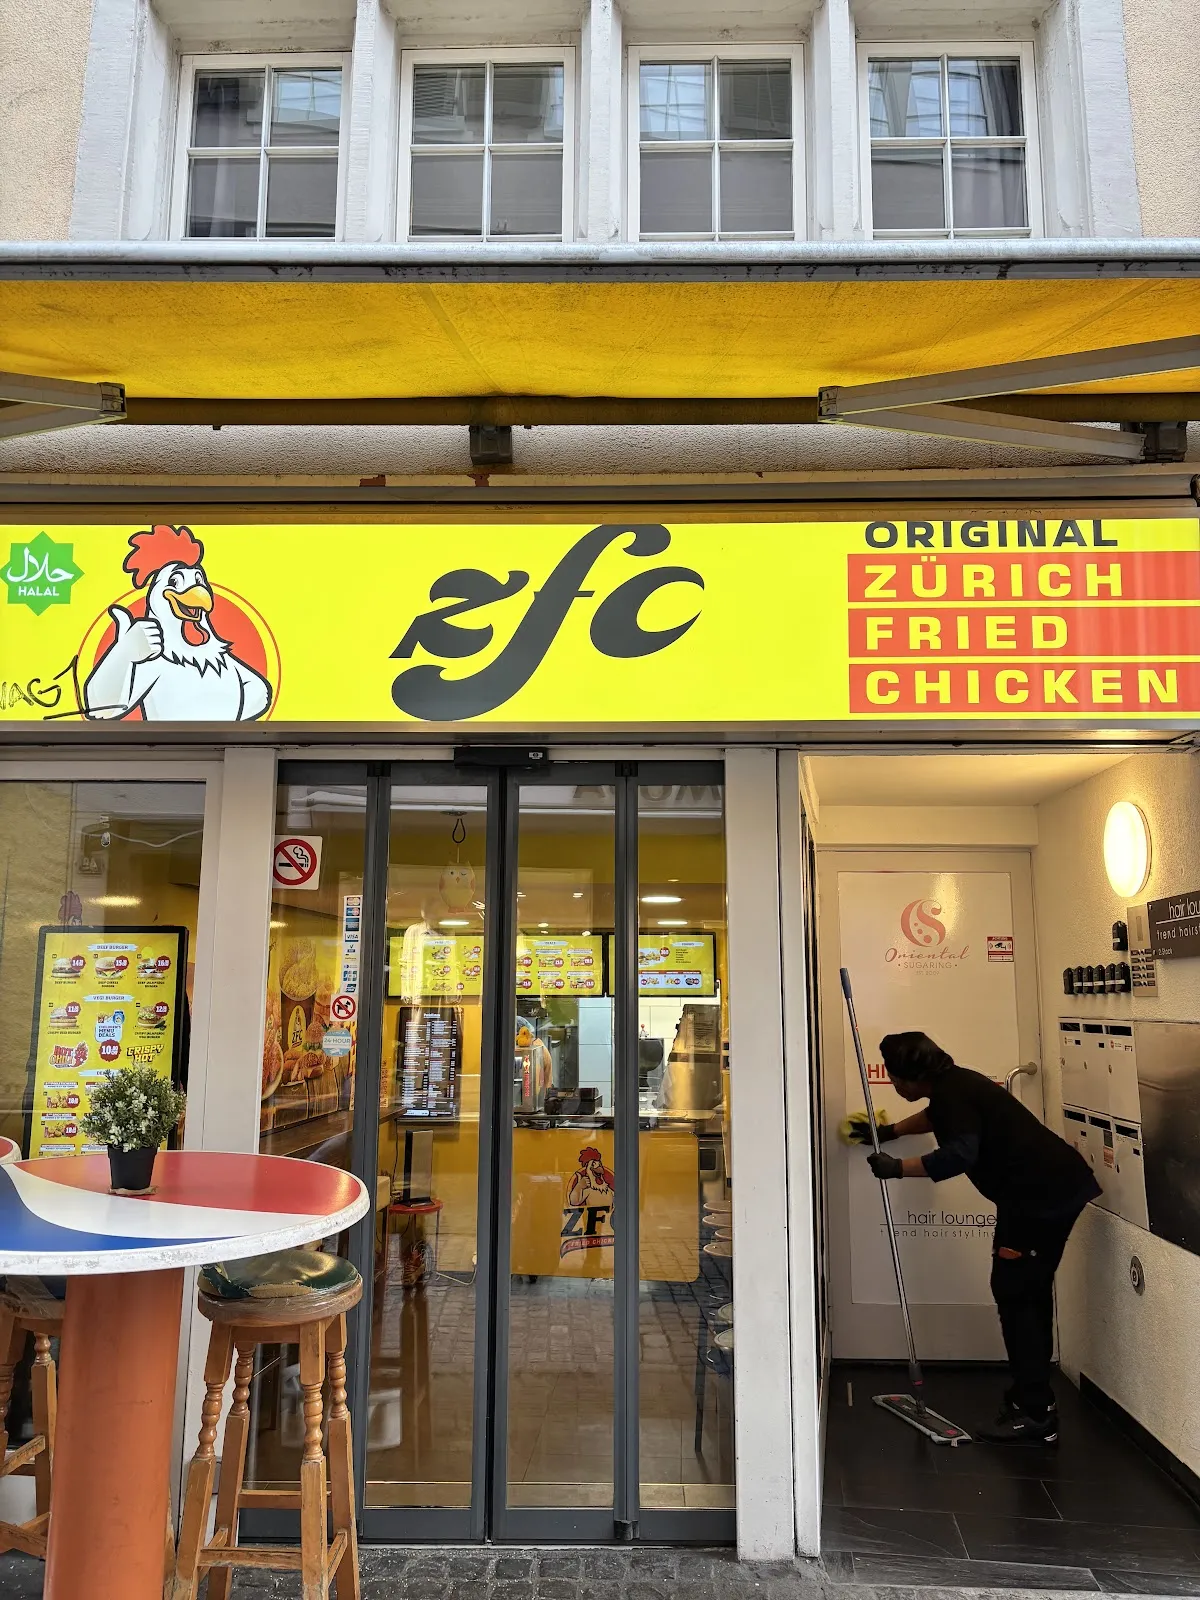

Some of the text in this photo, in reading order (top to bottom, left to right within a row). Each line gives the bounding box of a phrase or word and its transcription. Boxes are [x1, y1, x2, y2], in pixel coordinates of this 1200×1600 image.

[864, 519, 1119, 549] ORIGINAL
[864, 555, 1123, 599] ZÜRICH
[17, 585, 60, 597] HALAL
[865, 614, 1069, 650] FRIED
[865, 668, 1179, 705] CHICKEN
[1168, 898, 1185, 919] hair
[1157, 927, 1176, 941] trend
[884, 945, 970, 963] Oriental
[903, 961, 953, 969] SUGARING
[127, 1044, 165, 1057] CRISPY
[134, 1053, 156, 1063] HOT
[907, 1210, 998, 1228] hair lounge
[880, 1229, 917, 1238] tend
